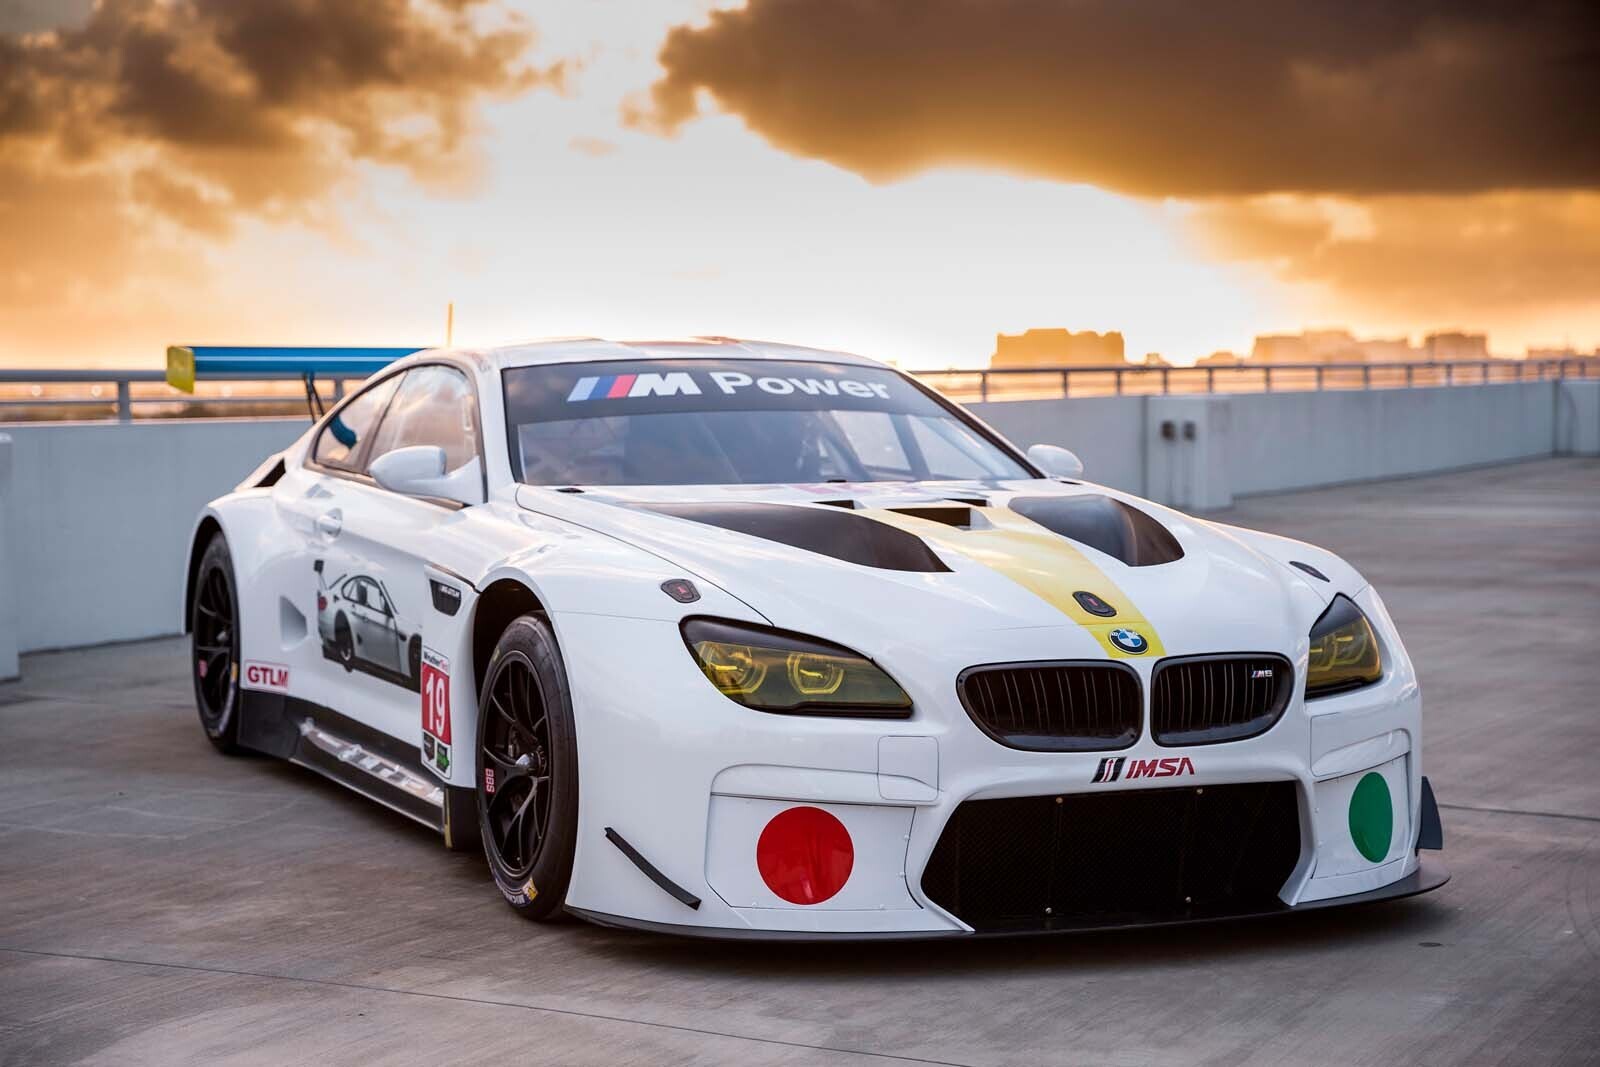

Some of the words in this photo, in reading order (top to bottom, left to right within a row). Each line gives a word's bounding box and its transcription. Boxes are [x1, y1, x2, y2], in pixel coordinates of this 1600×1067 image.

[709, 371, 891, 399] Power
[248, 666, 288, 687] GTLM
[425, 673, 446, 737] 19
[485, 768, 495, 792] BBS
[1125, 757, 1195, 779] IMSA
